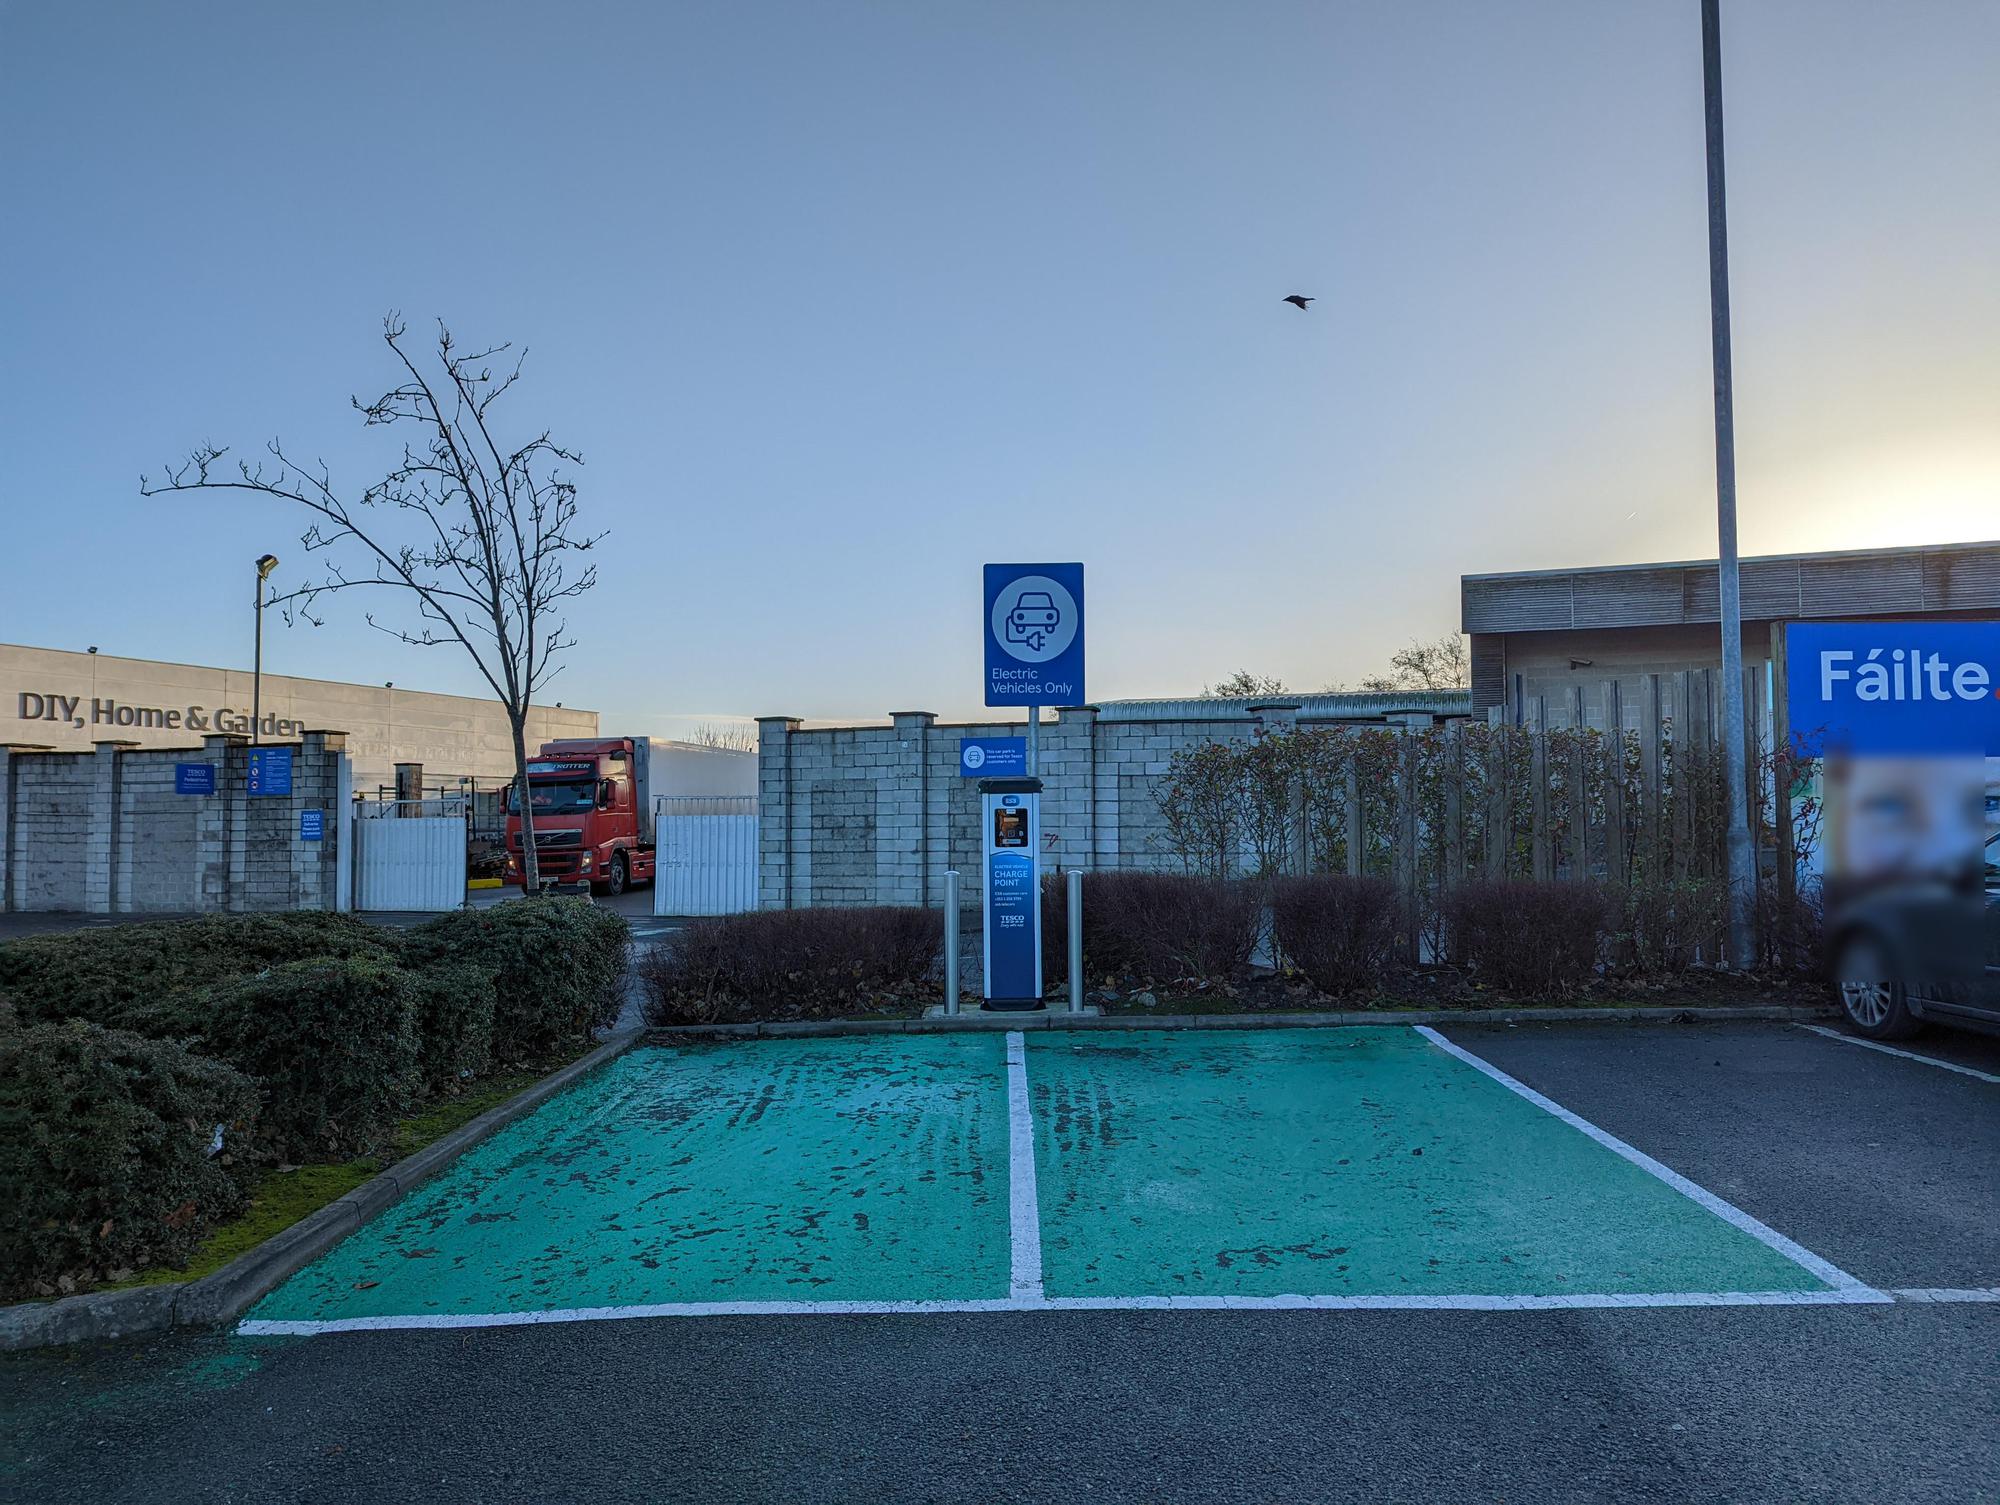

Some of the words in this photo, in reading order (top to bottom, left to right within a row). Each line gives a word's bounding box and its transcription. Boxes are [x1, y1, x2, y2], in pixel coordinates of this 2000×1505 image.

[992, 668, 1038, 679] Electric
[991, 682, 1041, 694] Vehicles
[1044, 682, 1072, 696] Only
[18, 692, 85, 729] DIY,
[91, 698, 181, 729] Home
[185, 705, 211, 732] &
[213, 708, 305, 738] Garden
